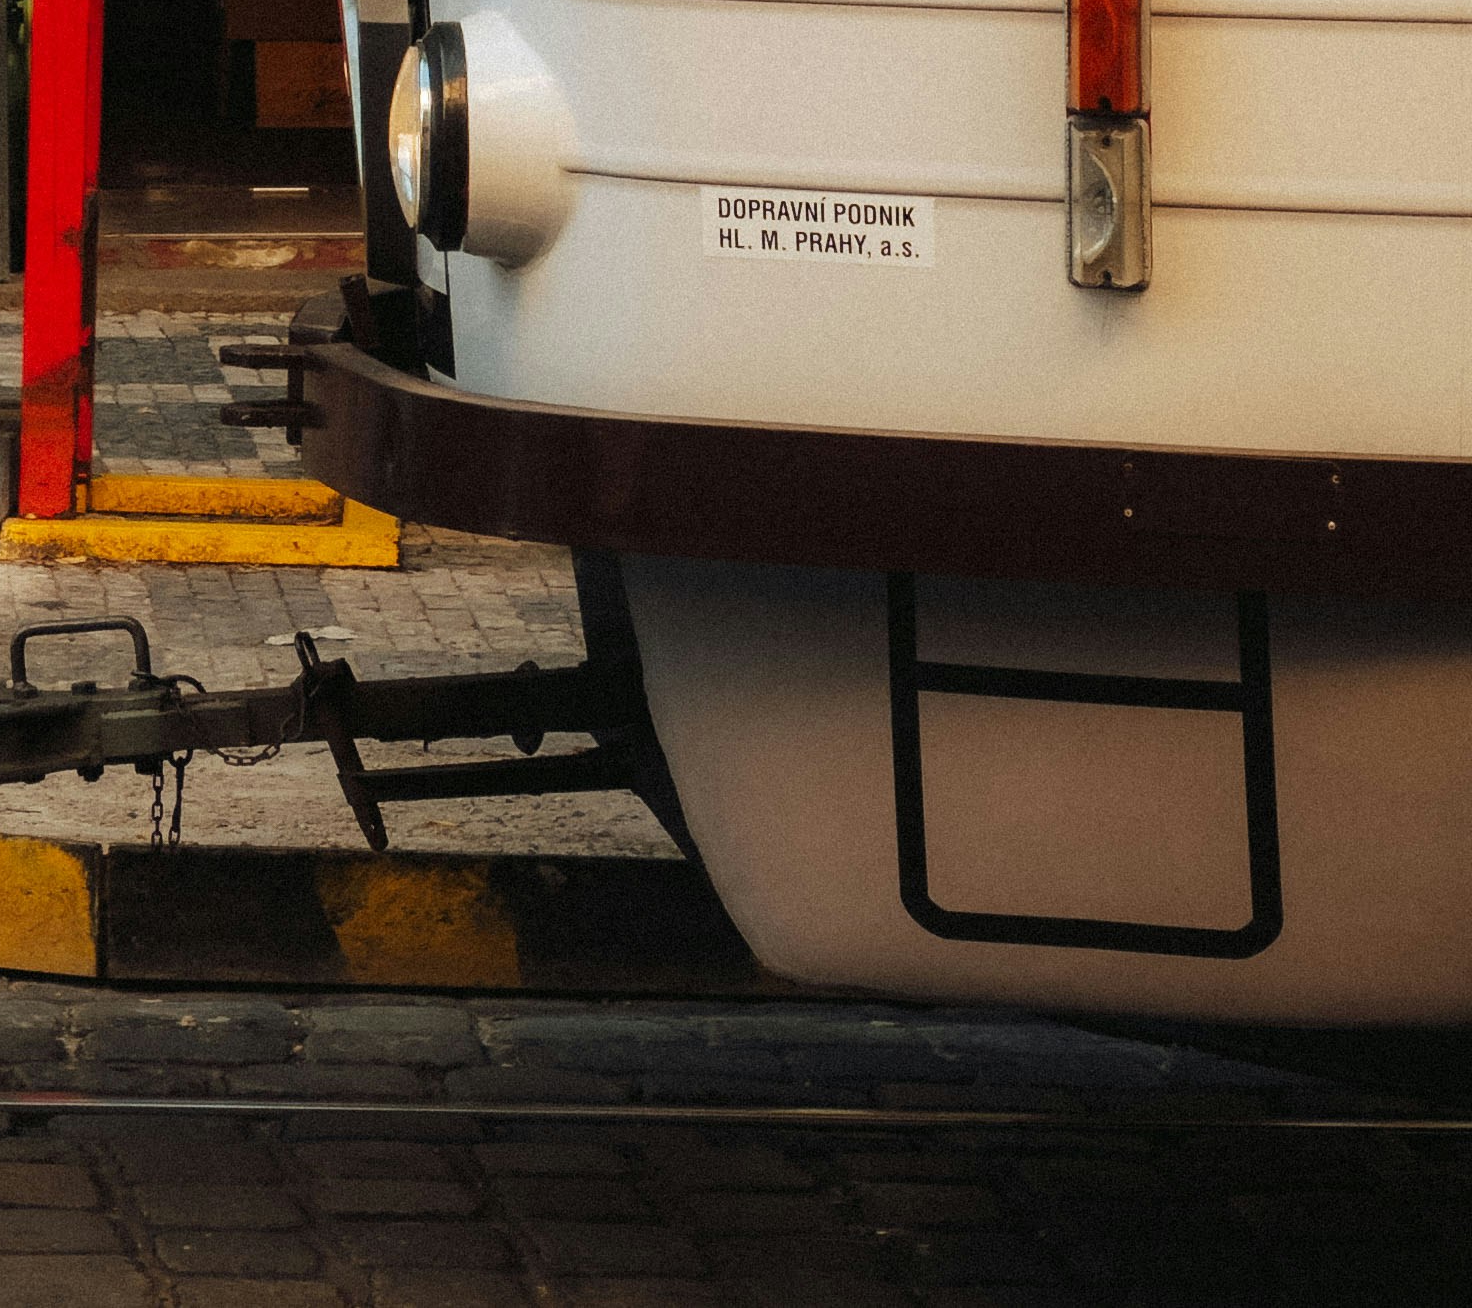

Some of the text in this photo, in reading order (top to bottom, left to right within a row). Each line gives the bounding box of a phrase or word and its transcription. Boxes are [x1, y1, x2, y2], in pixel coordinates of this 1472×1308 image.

[717, 196, 916, 228] DOPRAVNÍ PODNIK
[718, 228, 921, 259] HL. M. PRAHY, a.s.
